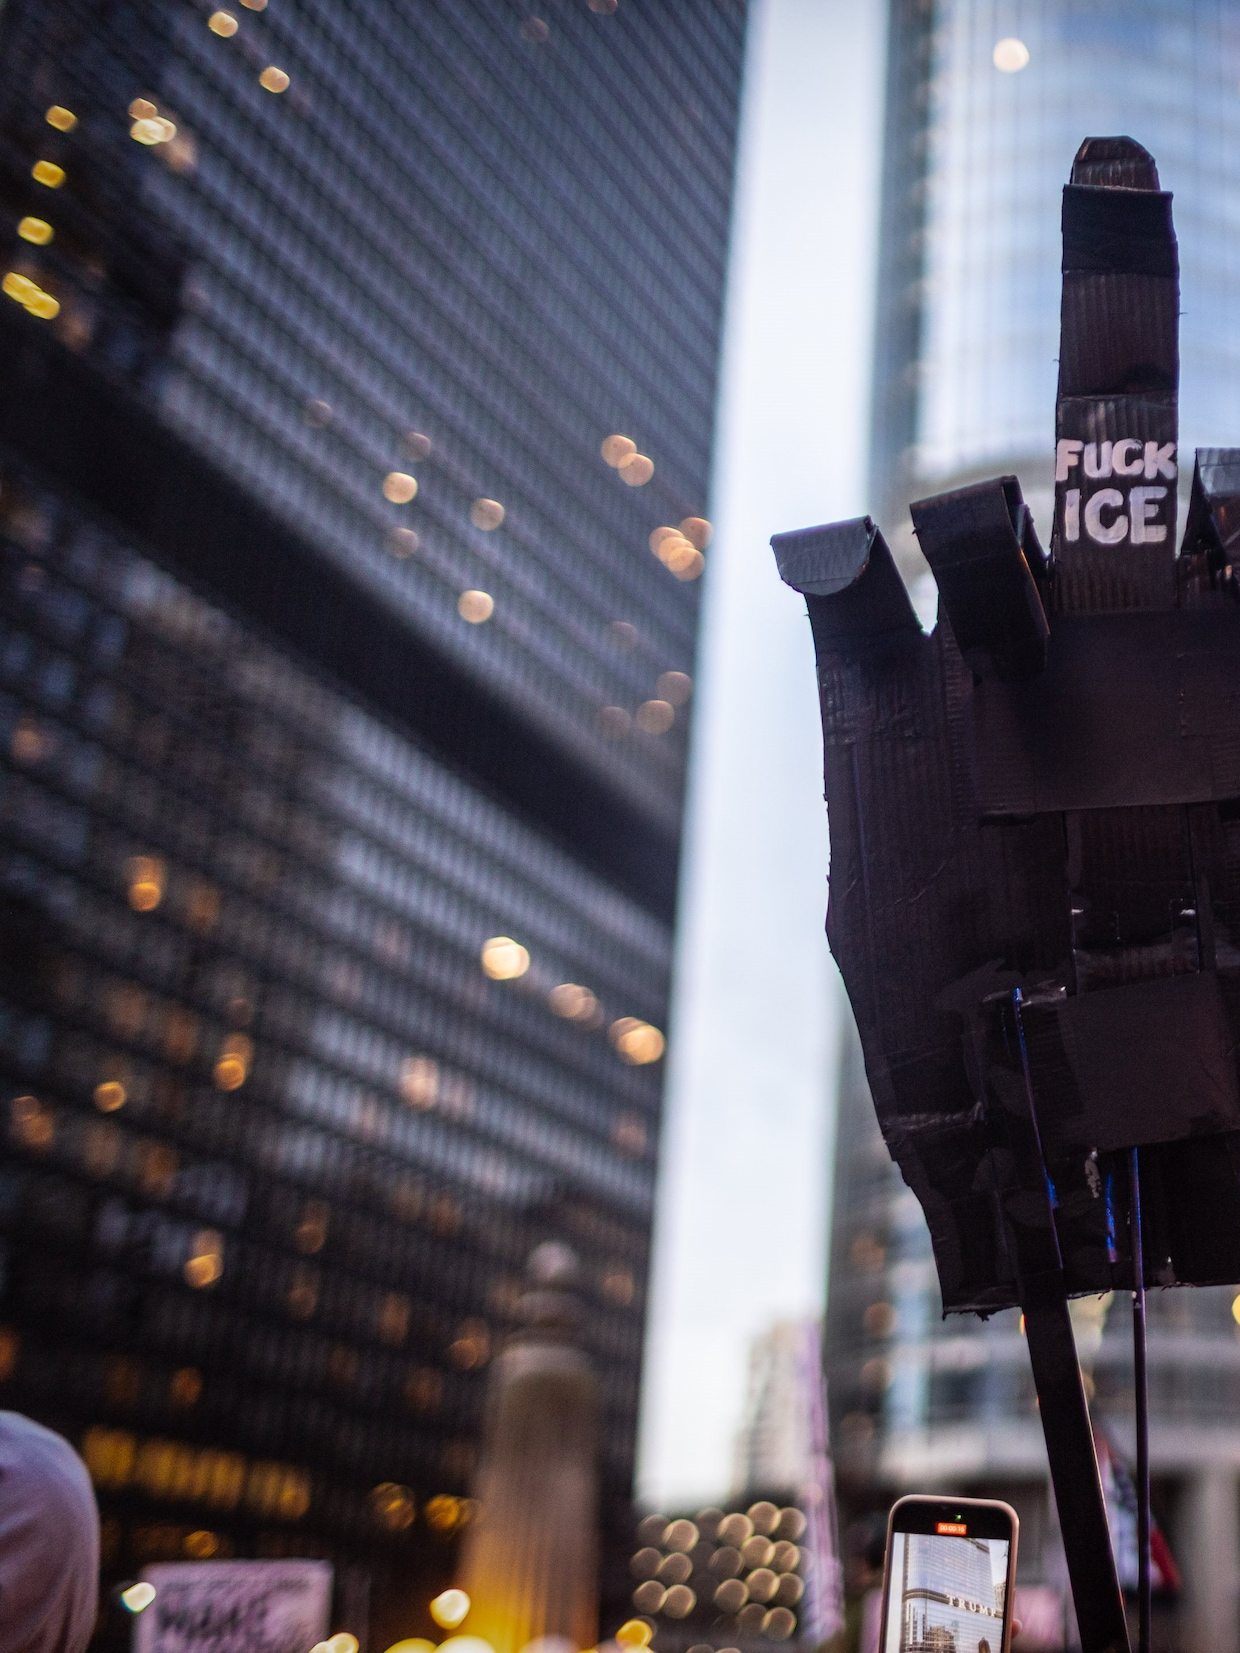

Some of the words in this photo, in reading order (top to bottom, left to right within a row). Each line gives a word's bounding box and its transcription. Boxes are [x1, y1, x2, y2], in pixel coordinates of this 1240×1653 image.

[1056, 438, 1177, 481] FUCK
[1065, 486, 1168, 543] ICE
[946, 1594, 996, 1617] TRUMP
